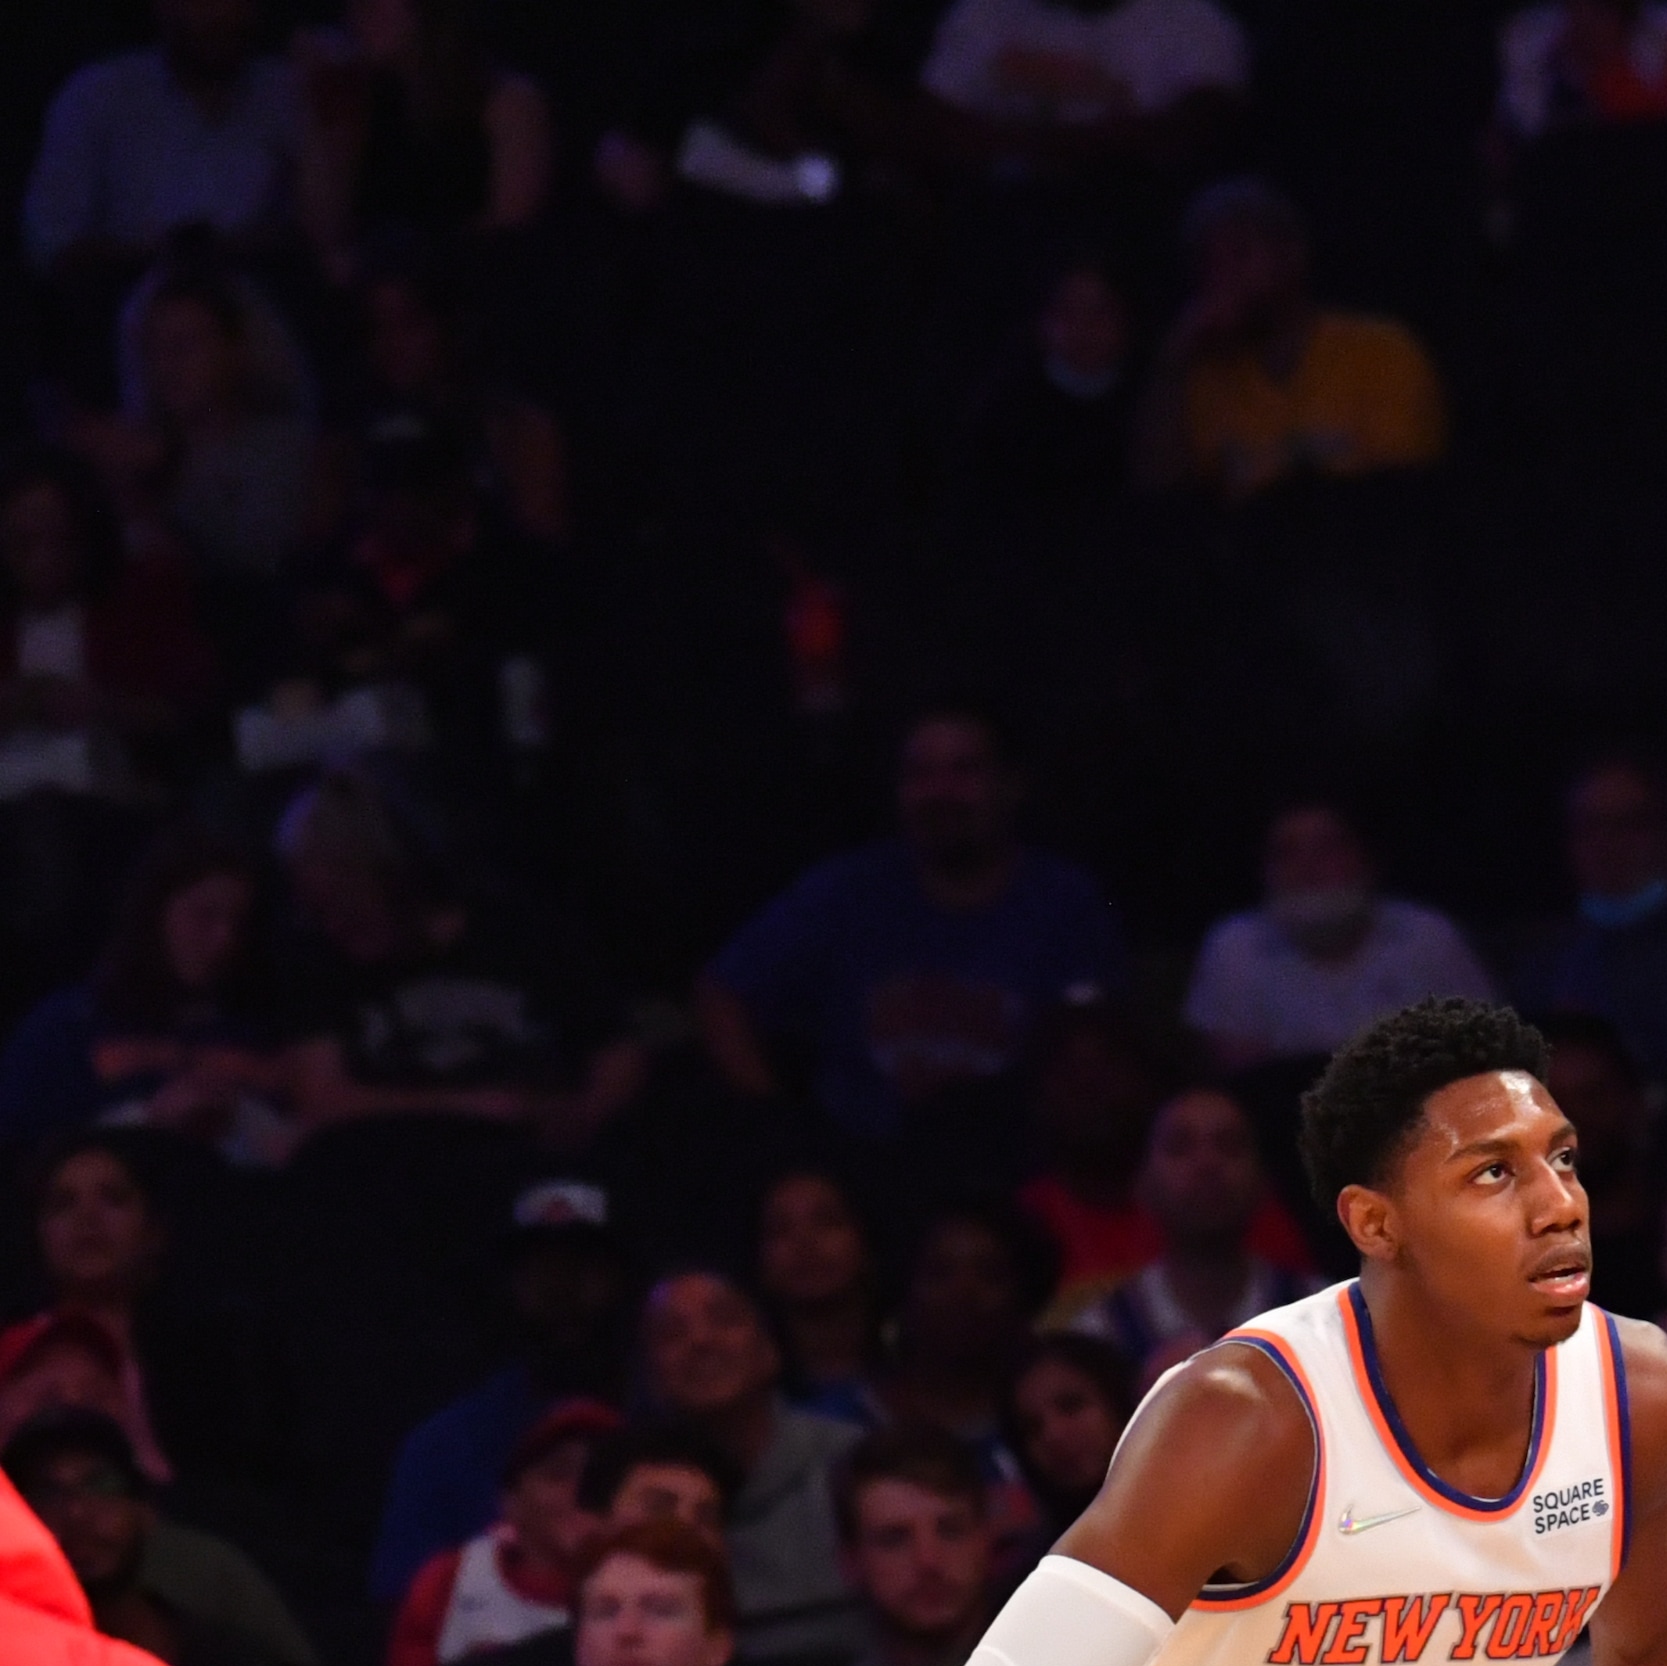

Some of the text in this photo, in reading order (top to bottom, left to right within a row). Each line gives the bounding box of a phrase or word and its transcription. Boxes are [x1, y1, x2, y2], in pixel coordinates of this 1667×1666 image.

[1533, 1478, 1604, 1513] SQUARE
[1535, 1503, 1591, 1534] SPACE
[1268, 1585, 1602, 1665] NEW YORK
